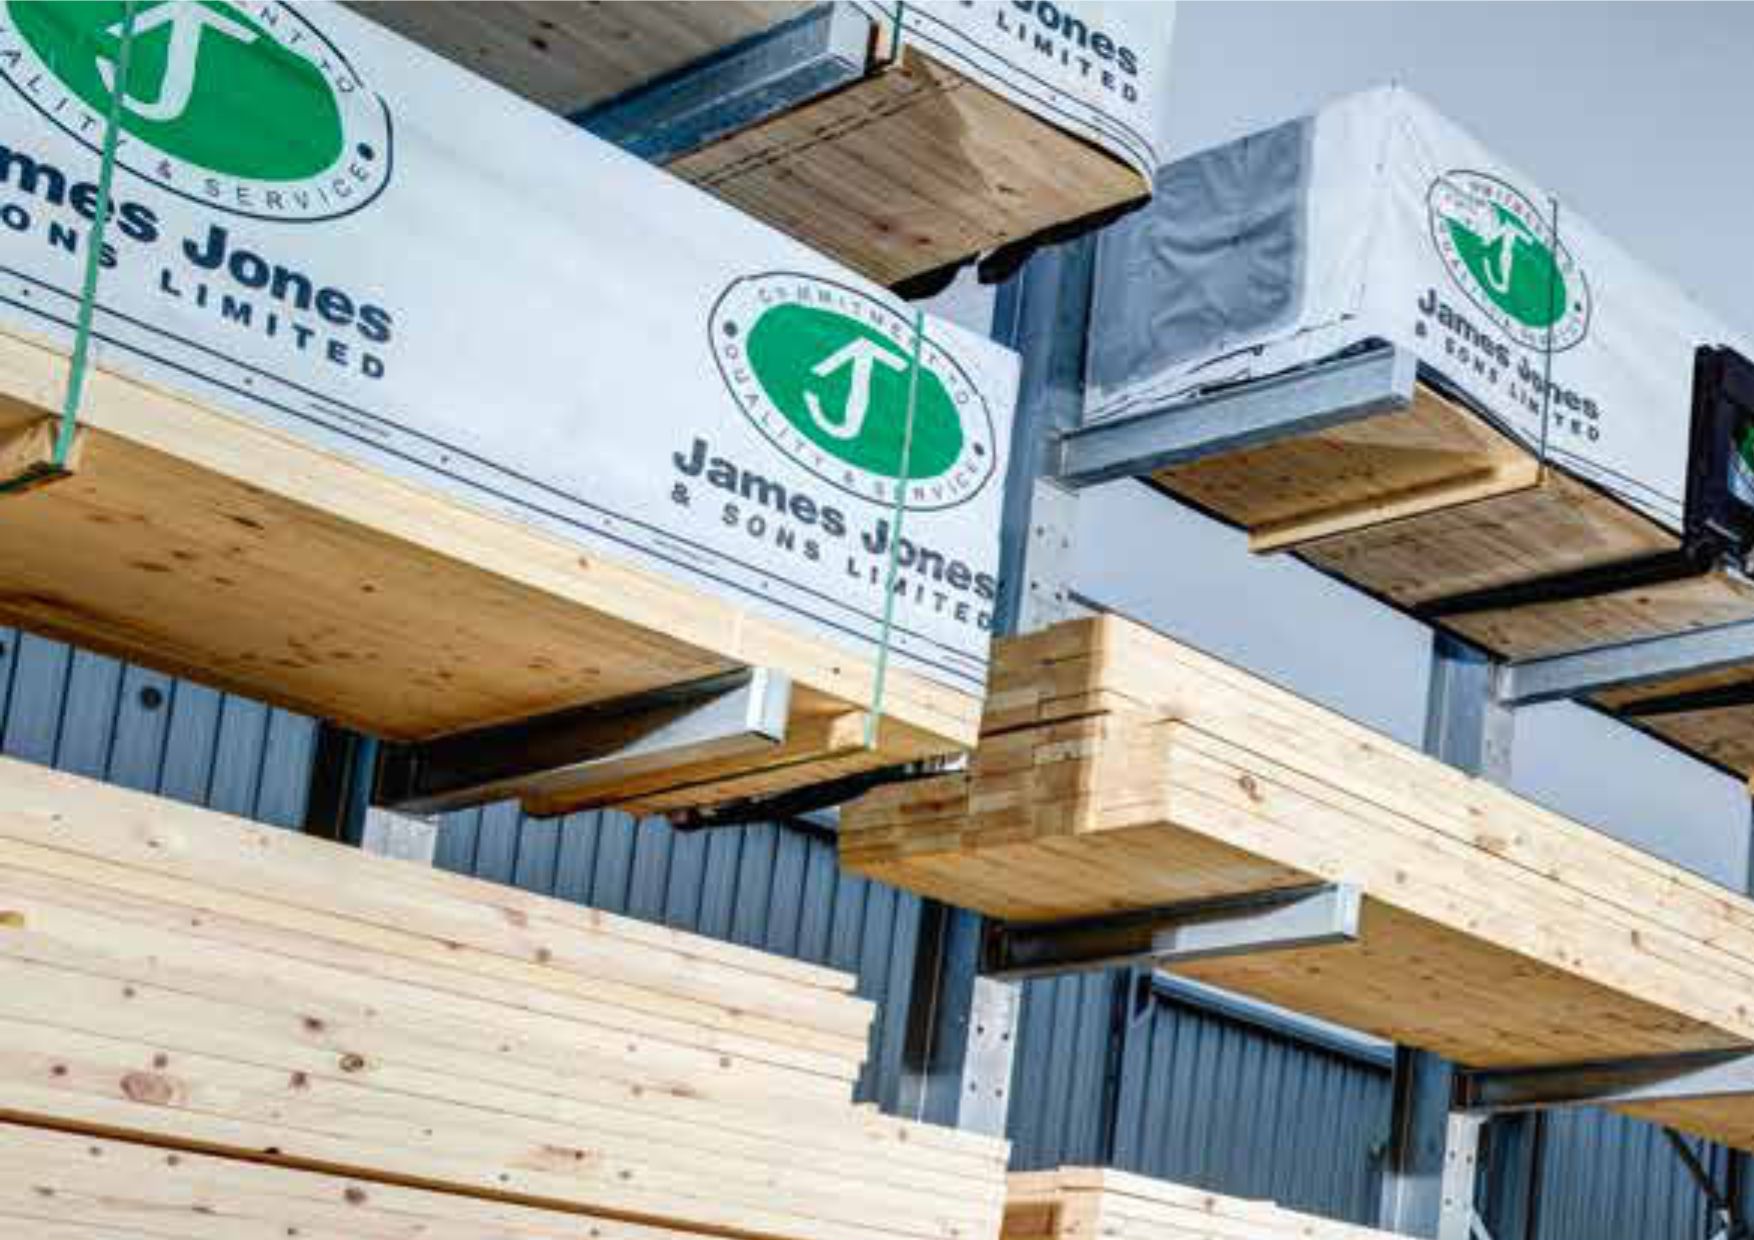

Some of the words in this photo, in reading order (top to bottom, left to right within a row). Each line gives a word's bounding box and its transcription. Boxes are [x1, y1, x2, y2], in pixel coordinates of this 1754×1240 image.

[995, 9, 1138, 102] LIMITED
[202, 161, 376, 210] SERVICE
[159, 268, 386, 380] LIMITED
[182, 222, 393, 344] Jones
[1418, 287, 1511, 369] James
[1516, 355, 1601, 421] Jones
[1510, 380, 1600, 443] LIMTED
[670, 480, 691, 507] &
[720, 501, 821, 562] SONS
[671, 437, 847, 537] James
[860, 517, 999, 602] Jones
